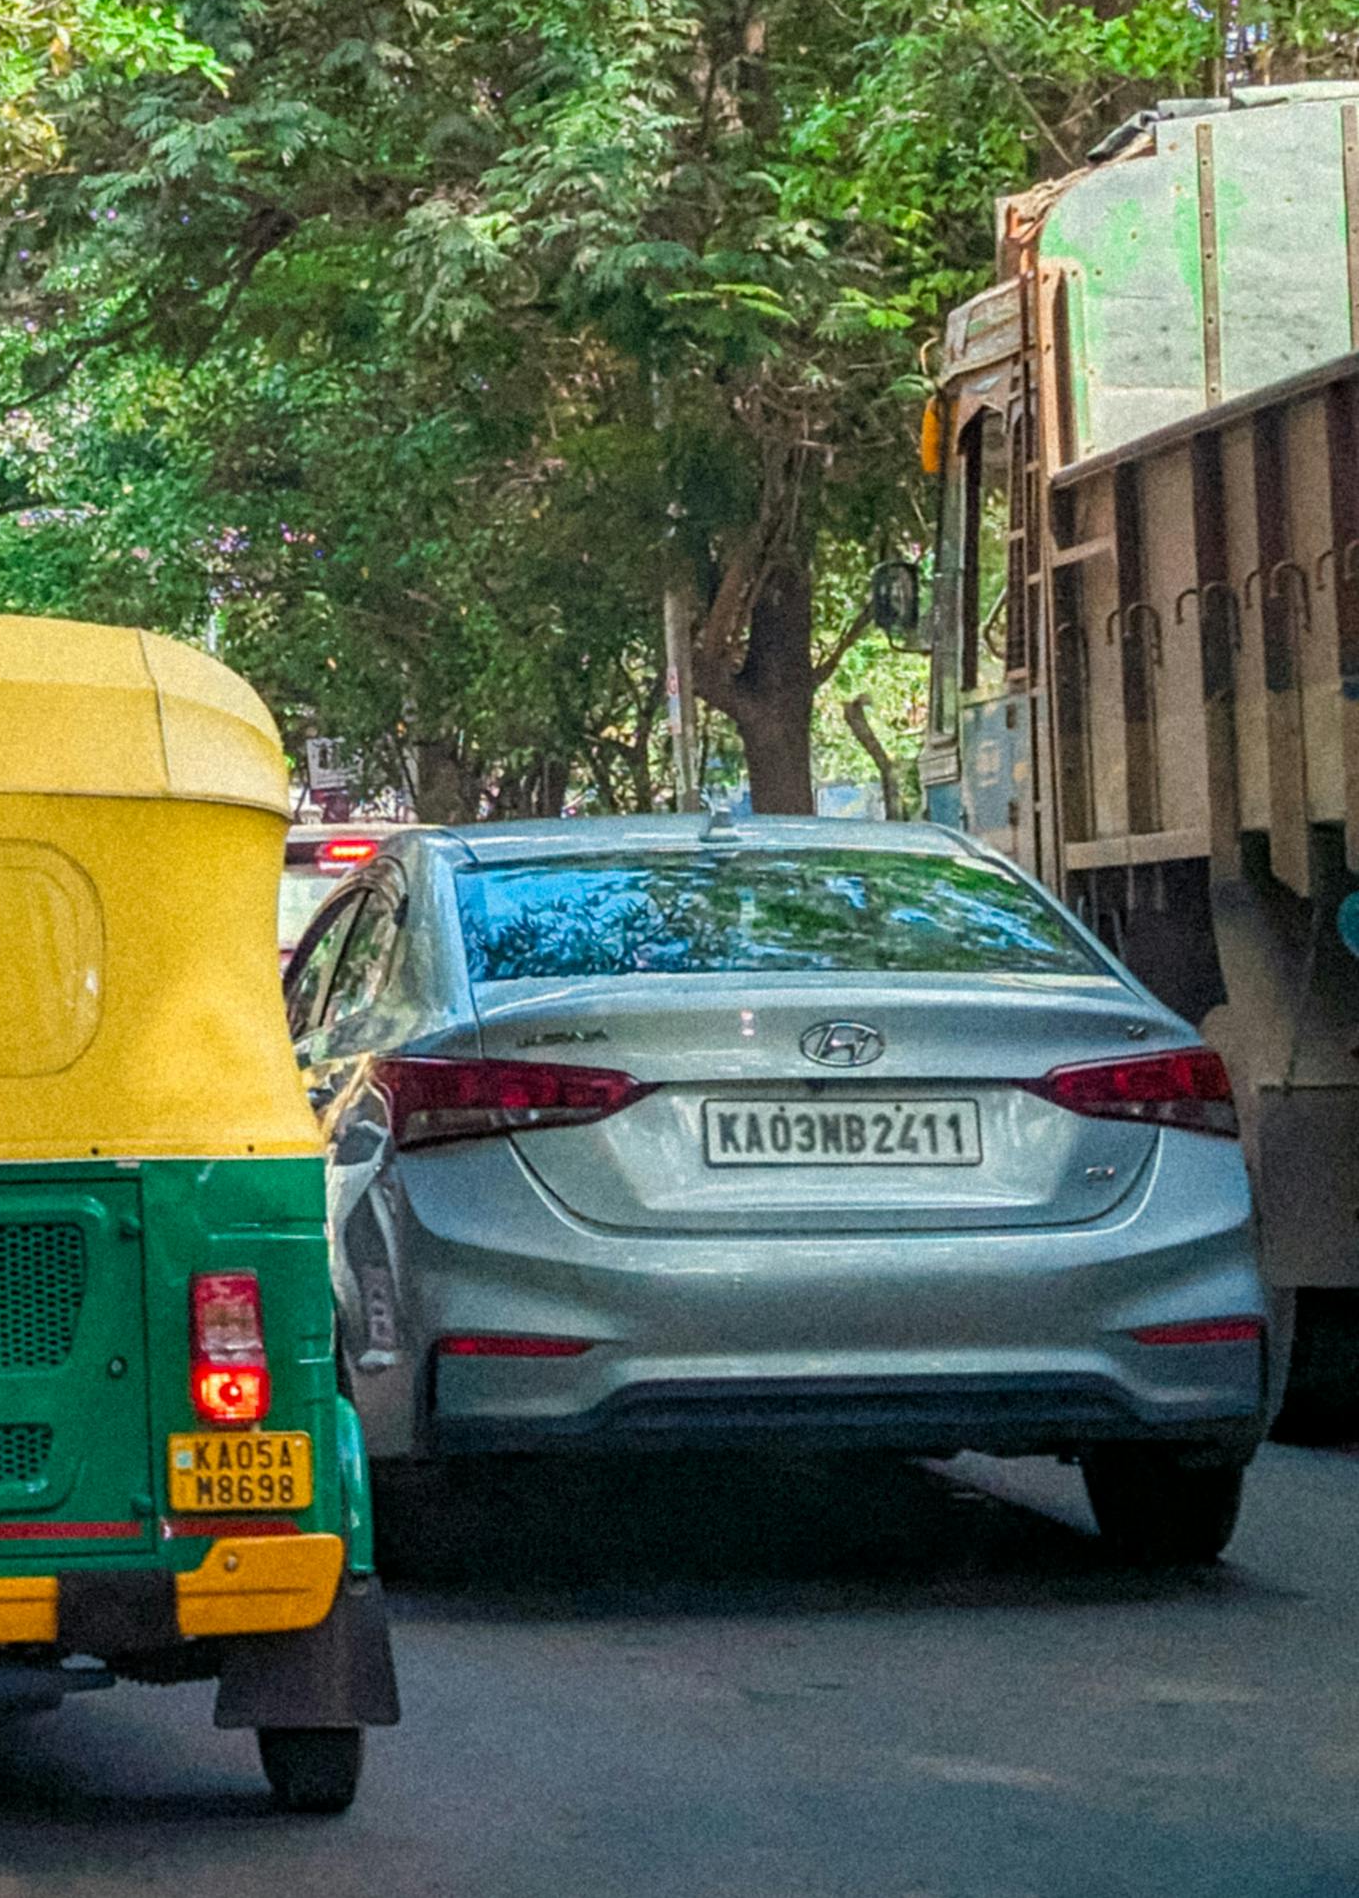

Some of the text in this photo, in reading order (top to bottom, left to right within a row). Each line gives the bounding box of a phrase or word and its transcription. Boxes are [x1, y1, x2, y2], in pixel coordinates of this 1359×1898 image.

[717, 1113, 964, 1155] KA03NB2411
[195, 1440, 293, 1470] KA05A
[196, 1474, 294, 1504] M8698
